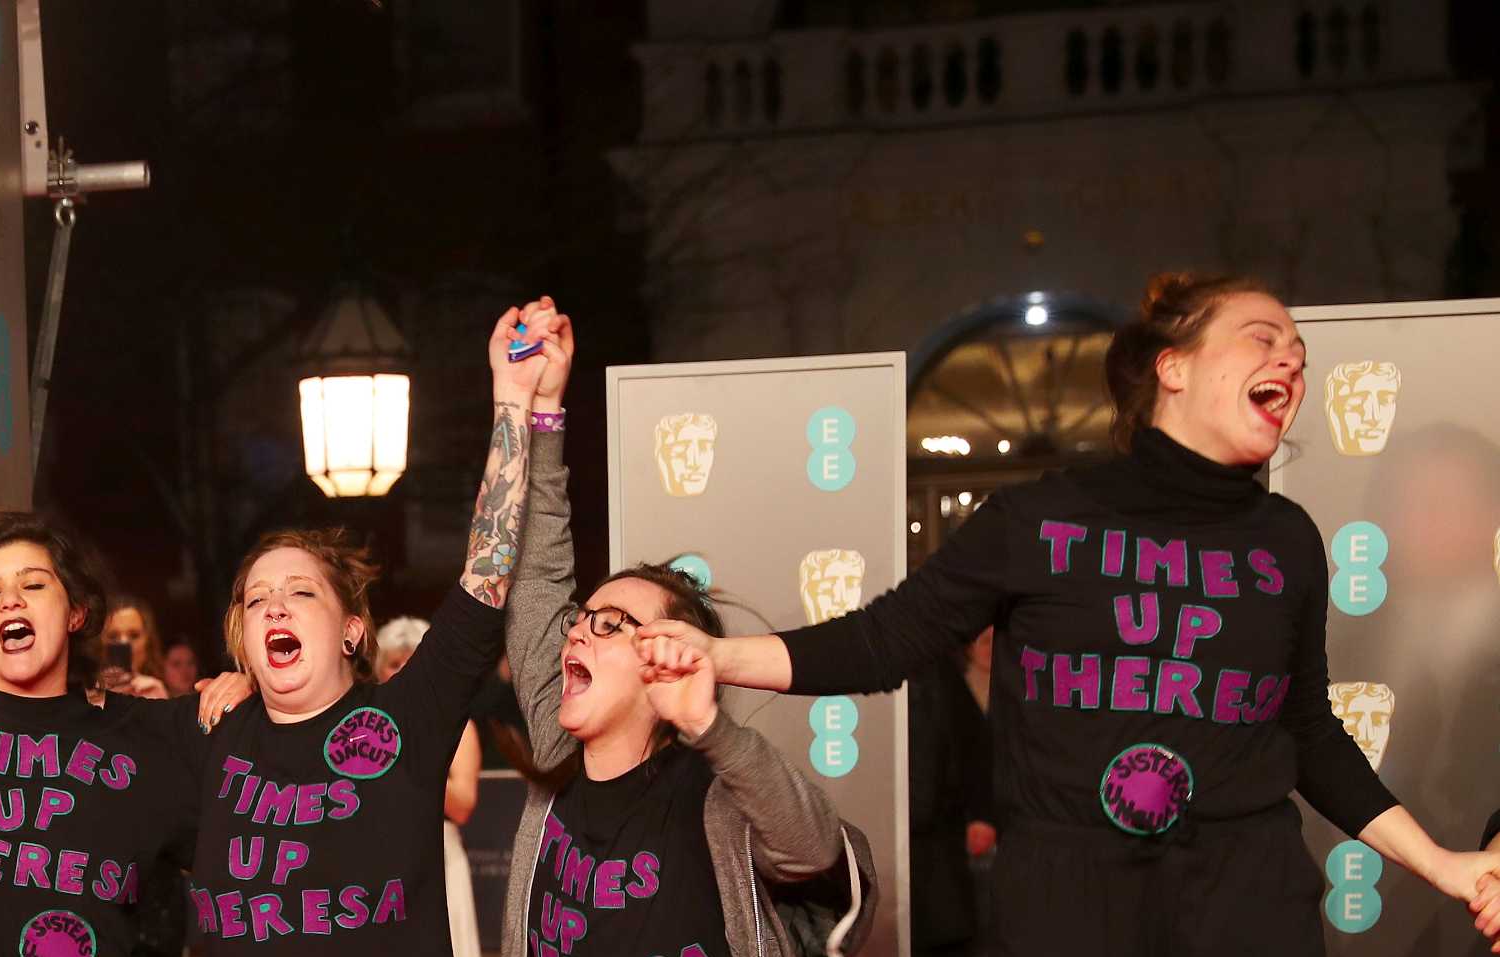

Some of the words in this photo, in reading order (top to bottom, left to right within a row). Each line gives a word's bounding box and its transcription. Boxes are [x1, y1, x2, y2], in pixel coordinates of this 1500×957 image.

[823, 418, 839, 480] EE
[1040, 519, 1284, 598] TIMES
[1350, 534, 1368, 604] EE
[1114, 592, 1222, 659] UP
[329, 741, 397, 768] UNCUT
[330, 711, 399, 748] SISTERS
[825, 705, 842, 766] EE
[218, 755, 360, 826] TIMES
[229, 836, 309, 886] UP
[541, 813, 660, 909] TIMES
[1344, 852, 1363, 920] EE
[31, 915, 92, 956] SISTERS
[189, 878, 406, 942] HERESA
[541, 892, 587, 955] UP
